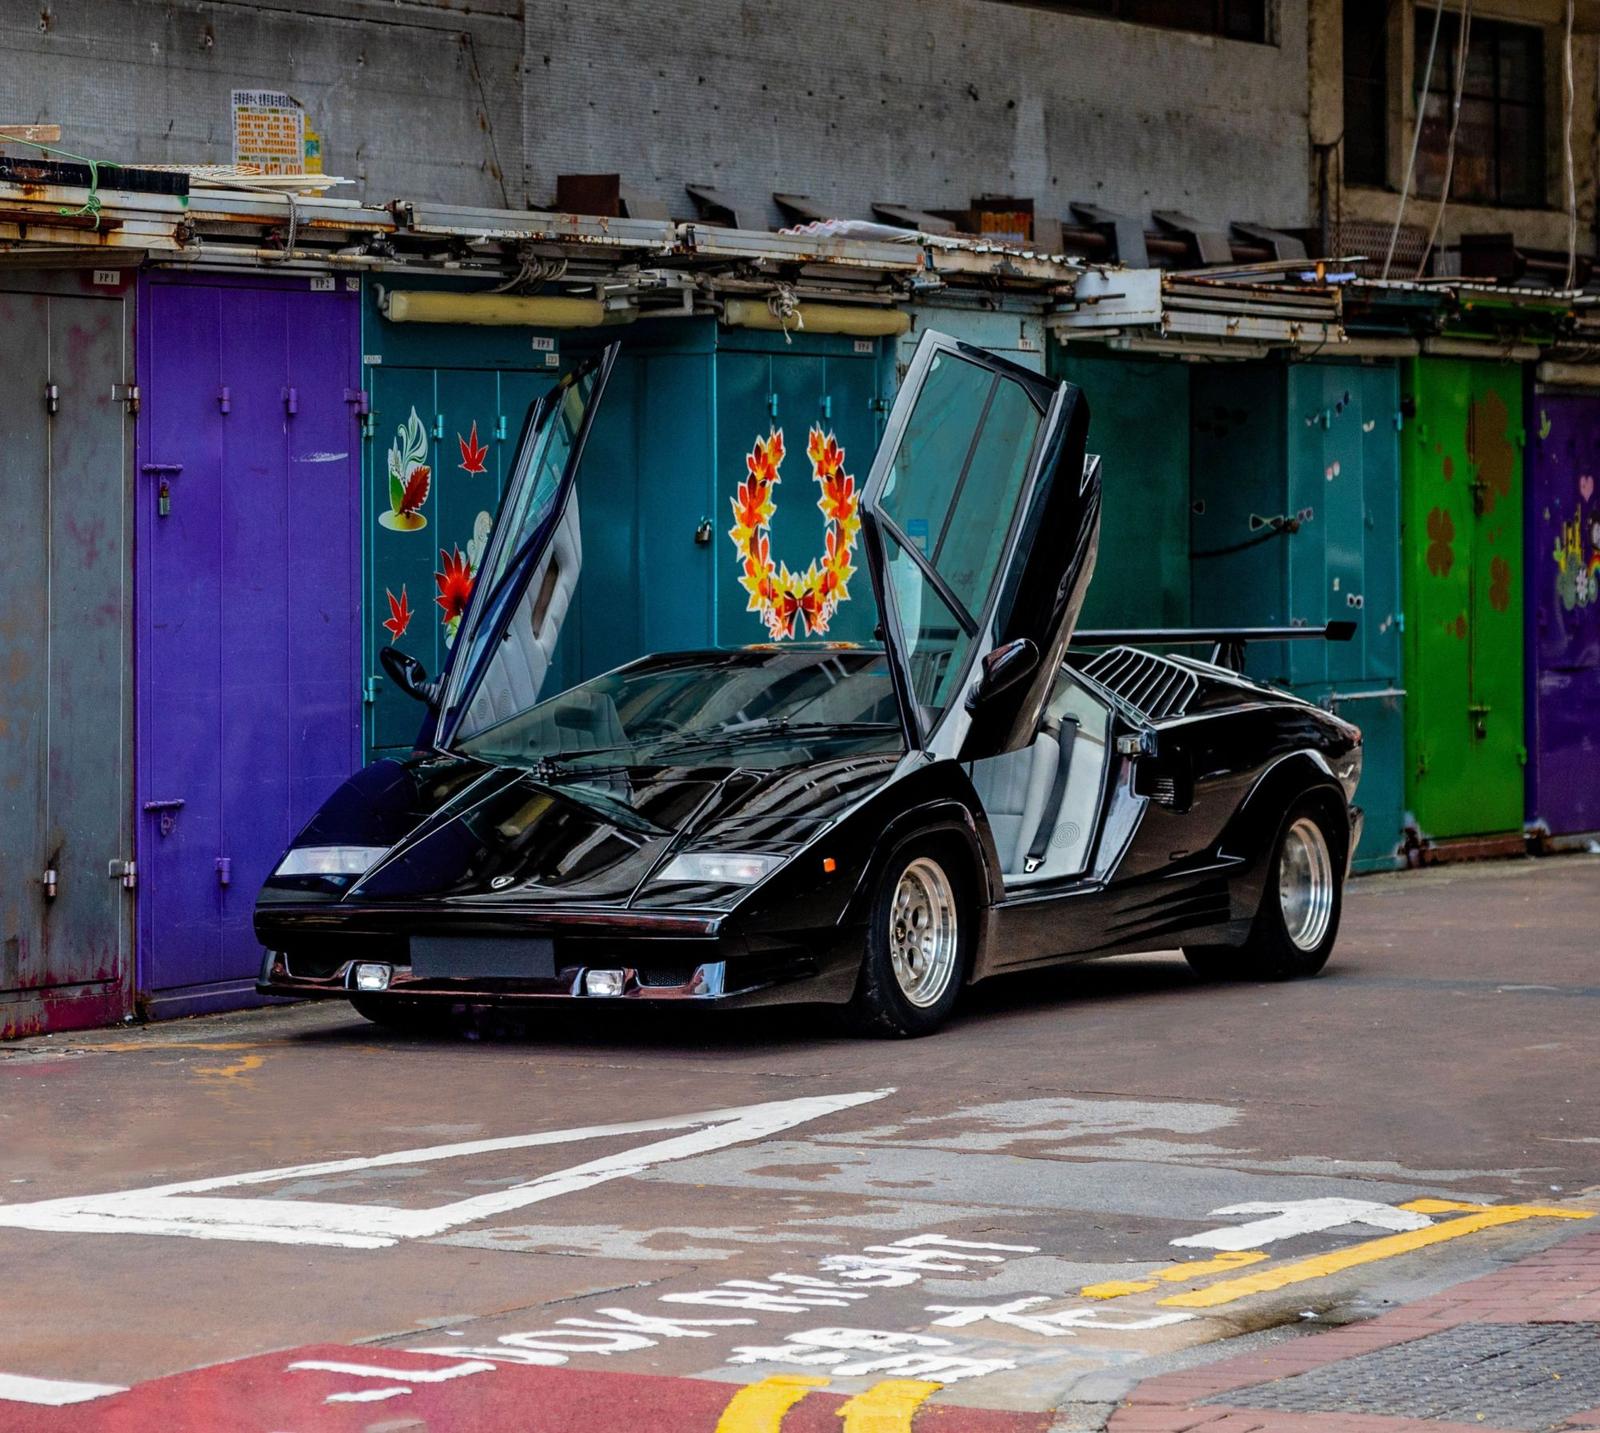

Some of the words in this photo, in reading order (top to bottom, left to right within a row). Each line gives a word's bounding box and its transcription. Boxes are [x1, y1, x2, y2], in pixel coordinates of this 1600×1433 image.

[286, 1306, 760, 1383] LOOK
[657, 1232, 1042, 1314] RIGHT
[724, 1295, 1198, 1384] 望右
